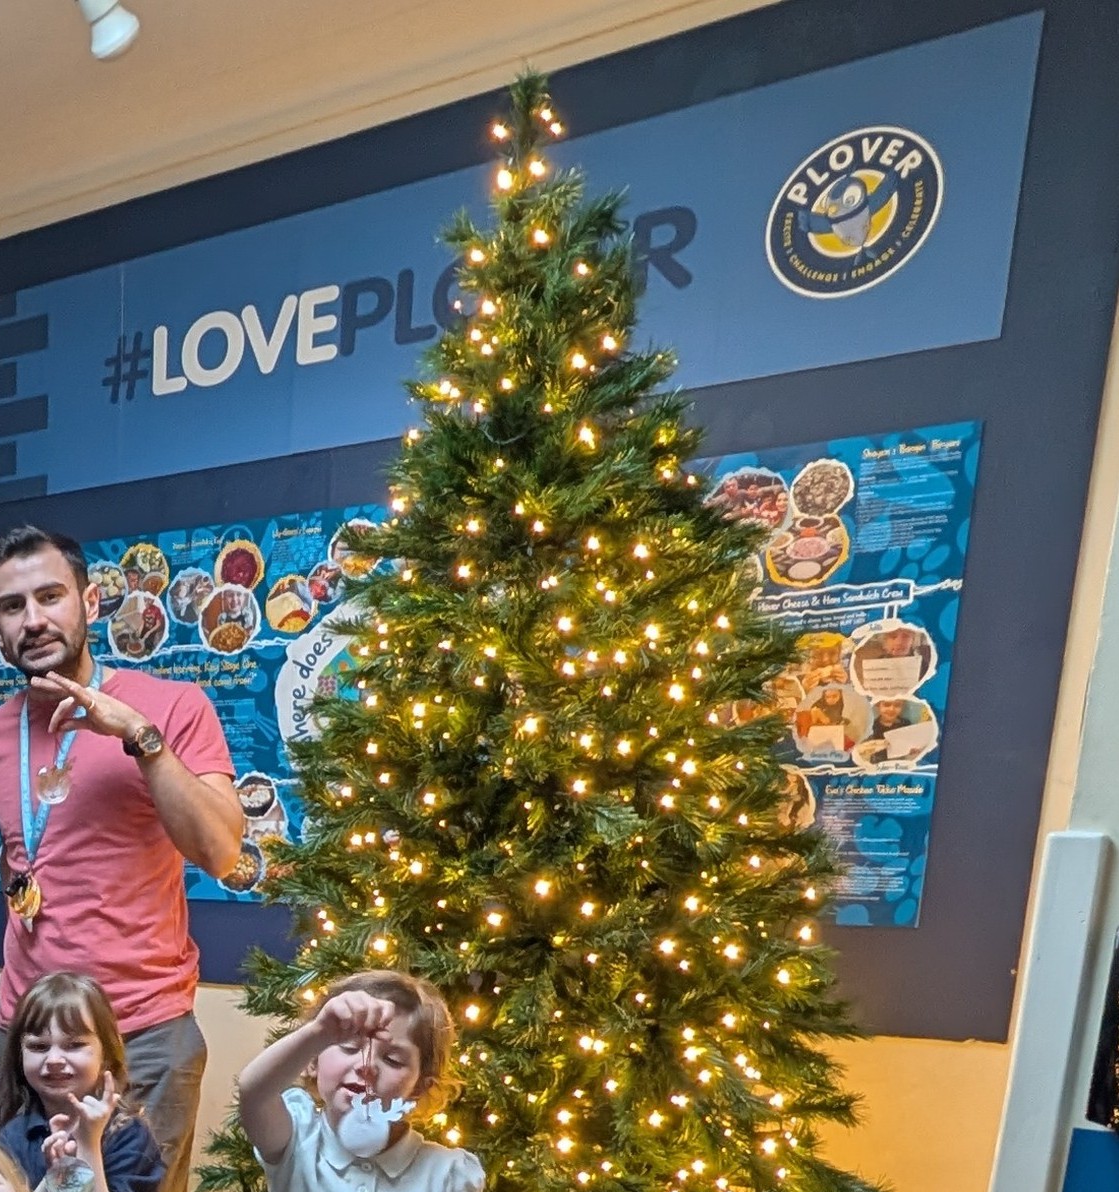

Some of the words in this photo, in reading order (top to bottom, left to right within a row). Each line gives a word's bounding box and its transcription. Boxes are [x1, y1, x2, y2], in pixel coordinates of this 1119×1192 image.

[787, 136, 923, 205] PLOVER
[842, 589, 880, 603] Sandwich
[292, 633, 333, 679] does
[290, 684, 312, 742] here
